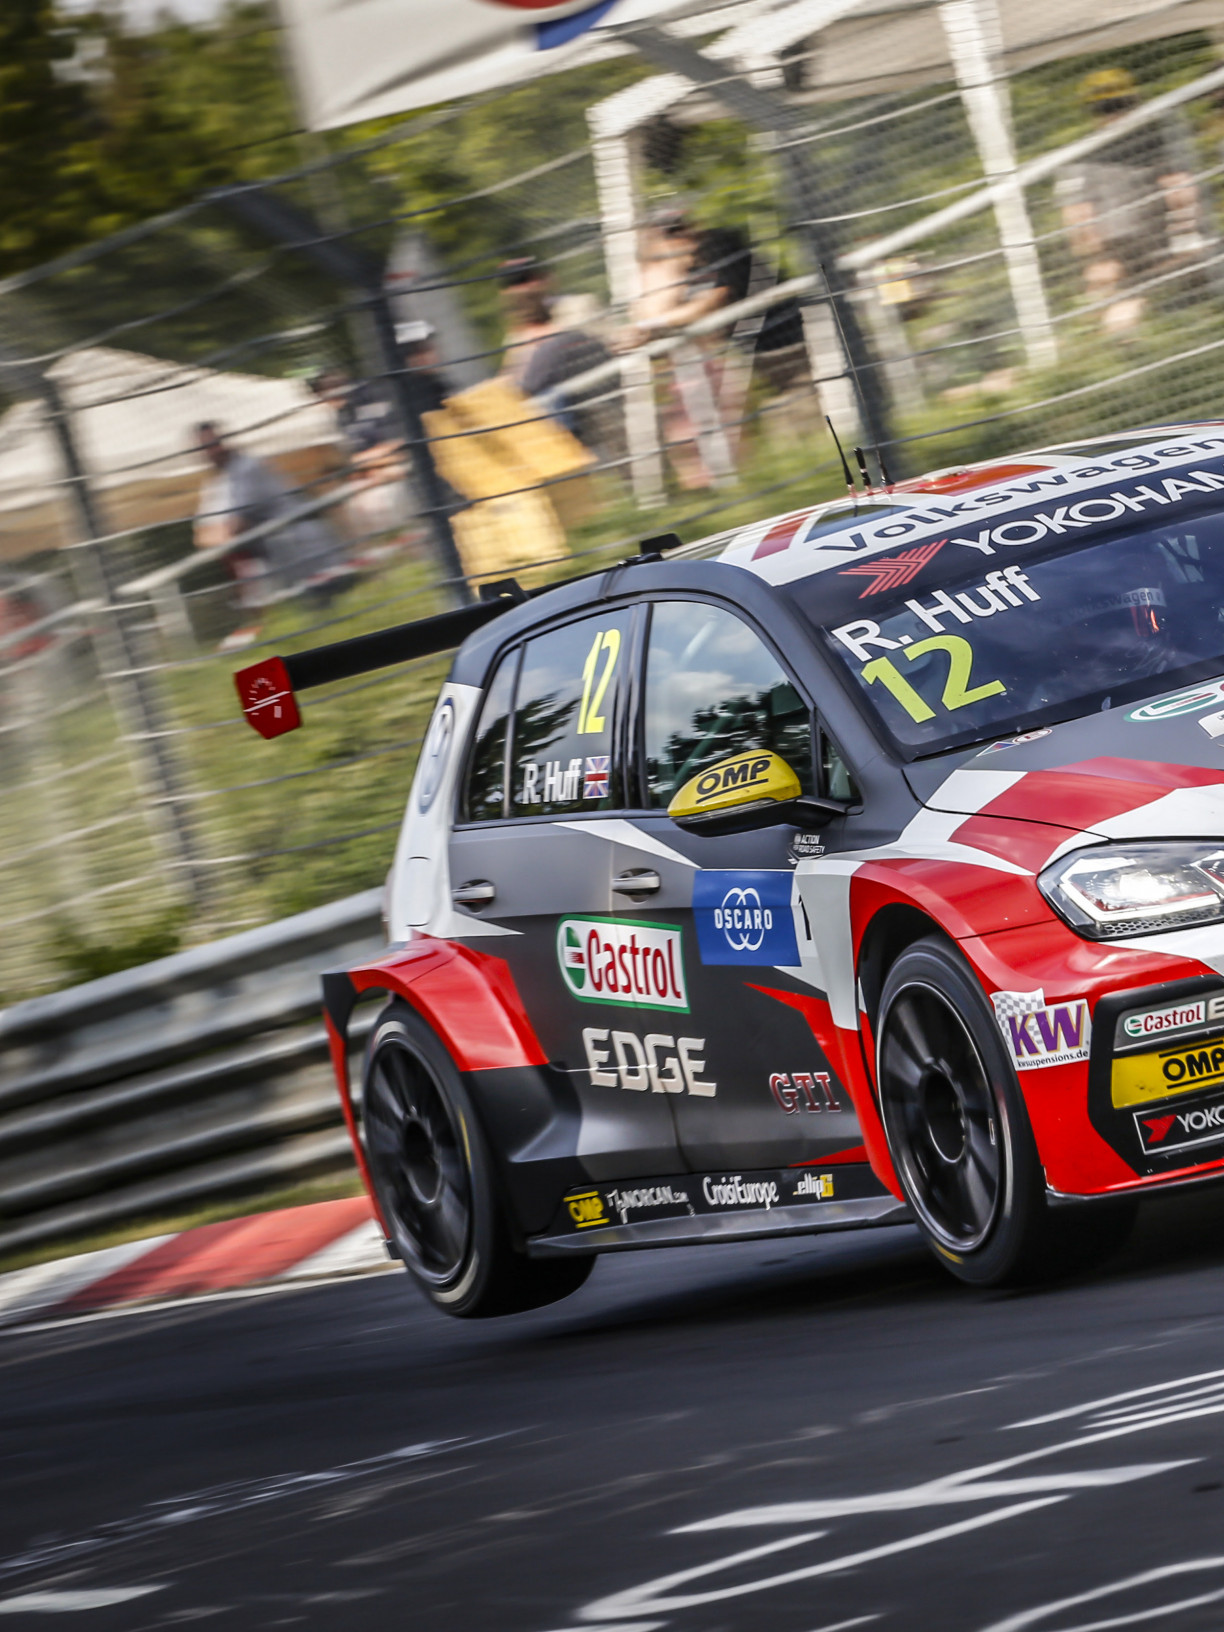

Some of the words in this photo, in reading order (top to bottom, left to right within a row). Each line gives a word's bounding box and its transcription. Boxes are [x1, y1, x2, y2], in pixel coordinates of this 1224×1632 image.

[831, 619, 913, 662] R.
[904, 565, 1041, 634] Huff
[577, 628, 621, 734] 12
[860, 634, 1007, 724] 12
[522, 763, 541, 805] R.
[543, 758, 583, 802] Huff
[696, 759, 771, 795] OMP
[714, 908, 773, 930] OSCARO
[587, 929, 682, 999] Castrol
[1007, 1004, 1087, 1058] KW
[1142, 1002, 1203, 1034] Castrol
[582, 1027, 717, 1097] EDGE
[769, 1072, 842, 1114] GTI
[569, 1197, 604, 1222] OMP
[702, 1176, 779, 1210] CroisiEurope
